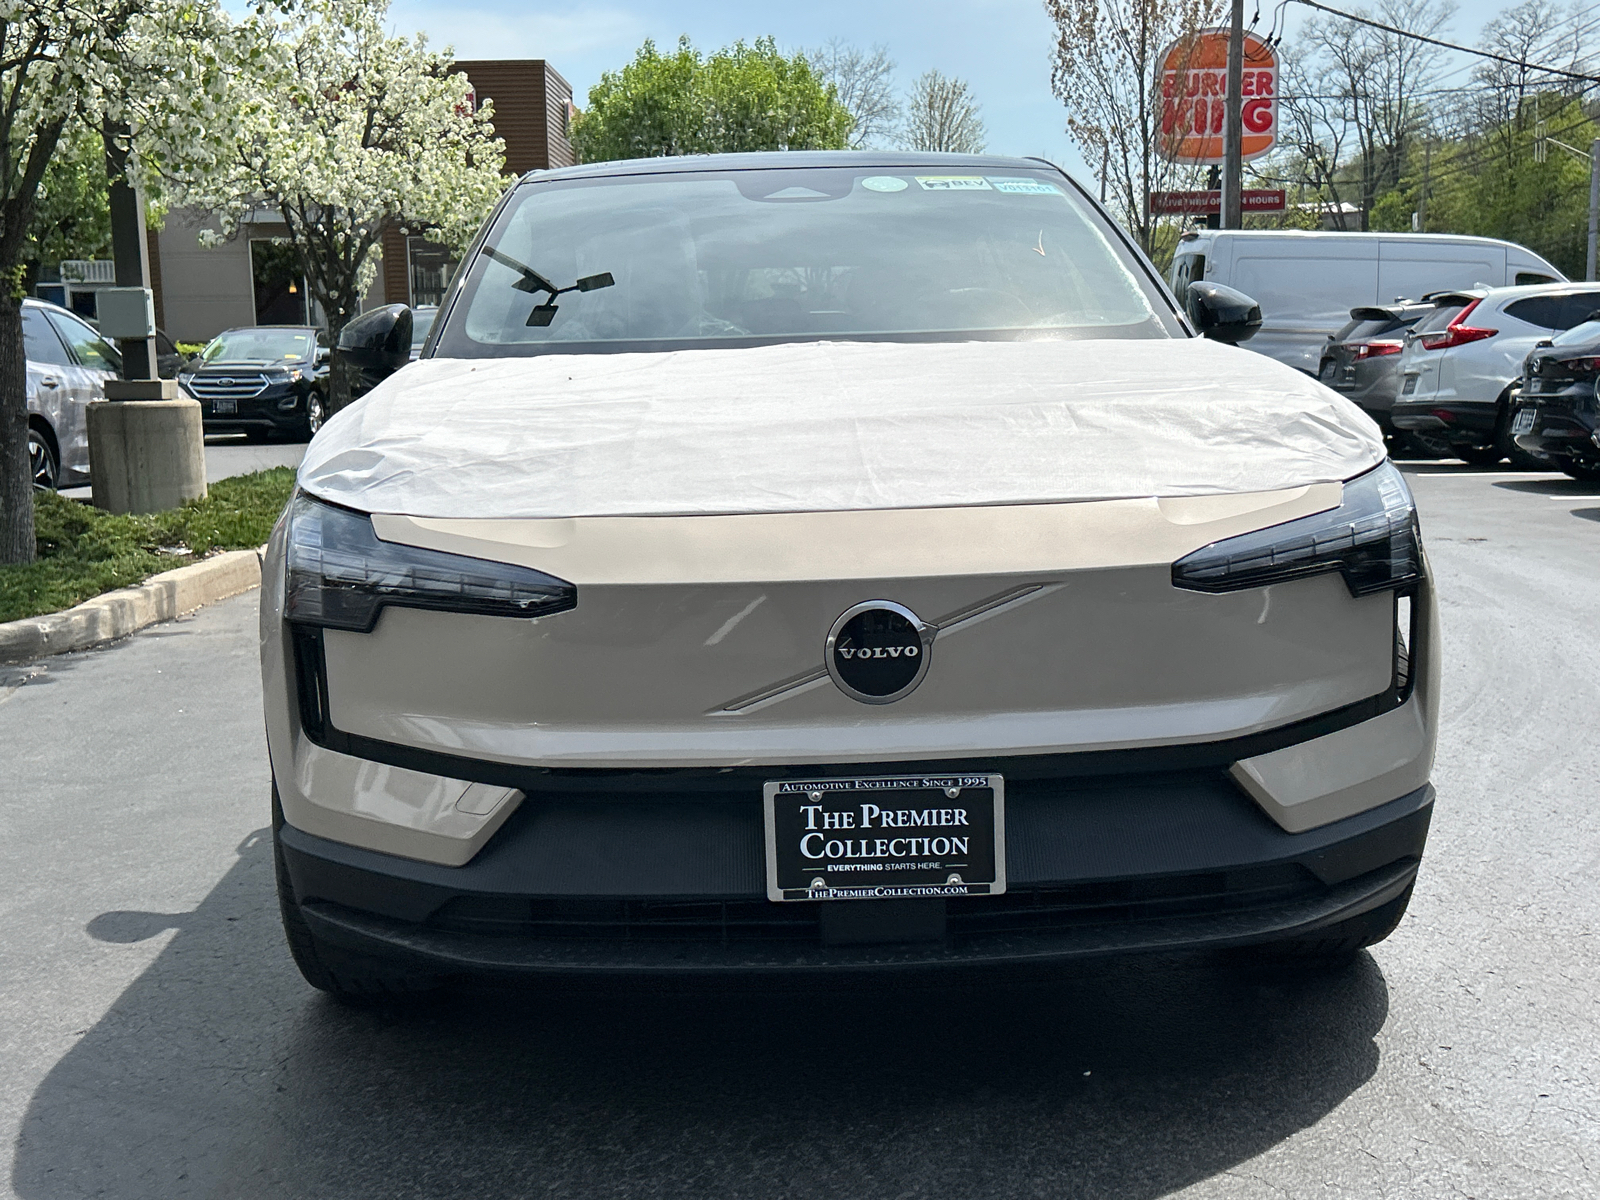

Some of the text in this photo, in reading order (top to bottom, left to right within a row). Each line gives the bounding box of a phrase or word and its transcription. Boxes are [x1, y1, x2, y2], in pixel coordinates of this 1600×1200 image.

[1162, 71, 1274, 98] BURER
[1249, 195, 1280, 205] HOURS
[838, 645, 919, 659] VOLVO
[781, 777, 987, 792] AUTOMOTIVE EXCELLENCE SINCE 1995
[800, 803, 969, 830] THE PREMIER
[800, 832, 970, 859] COLLECTION
[827, 861, 943, 872] EVERYTHING STARTS HERE.
[805, 886, 969, 899] THEPREMIERCOLLECTION.COM
